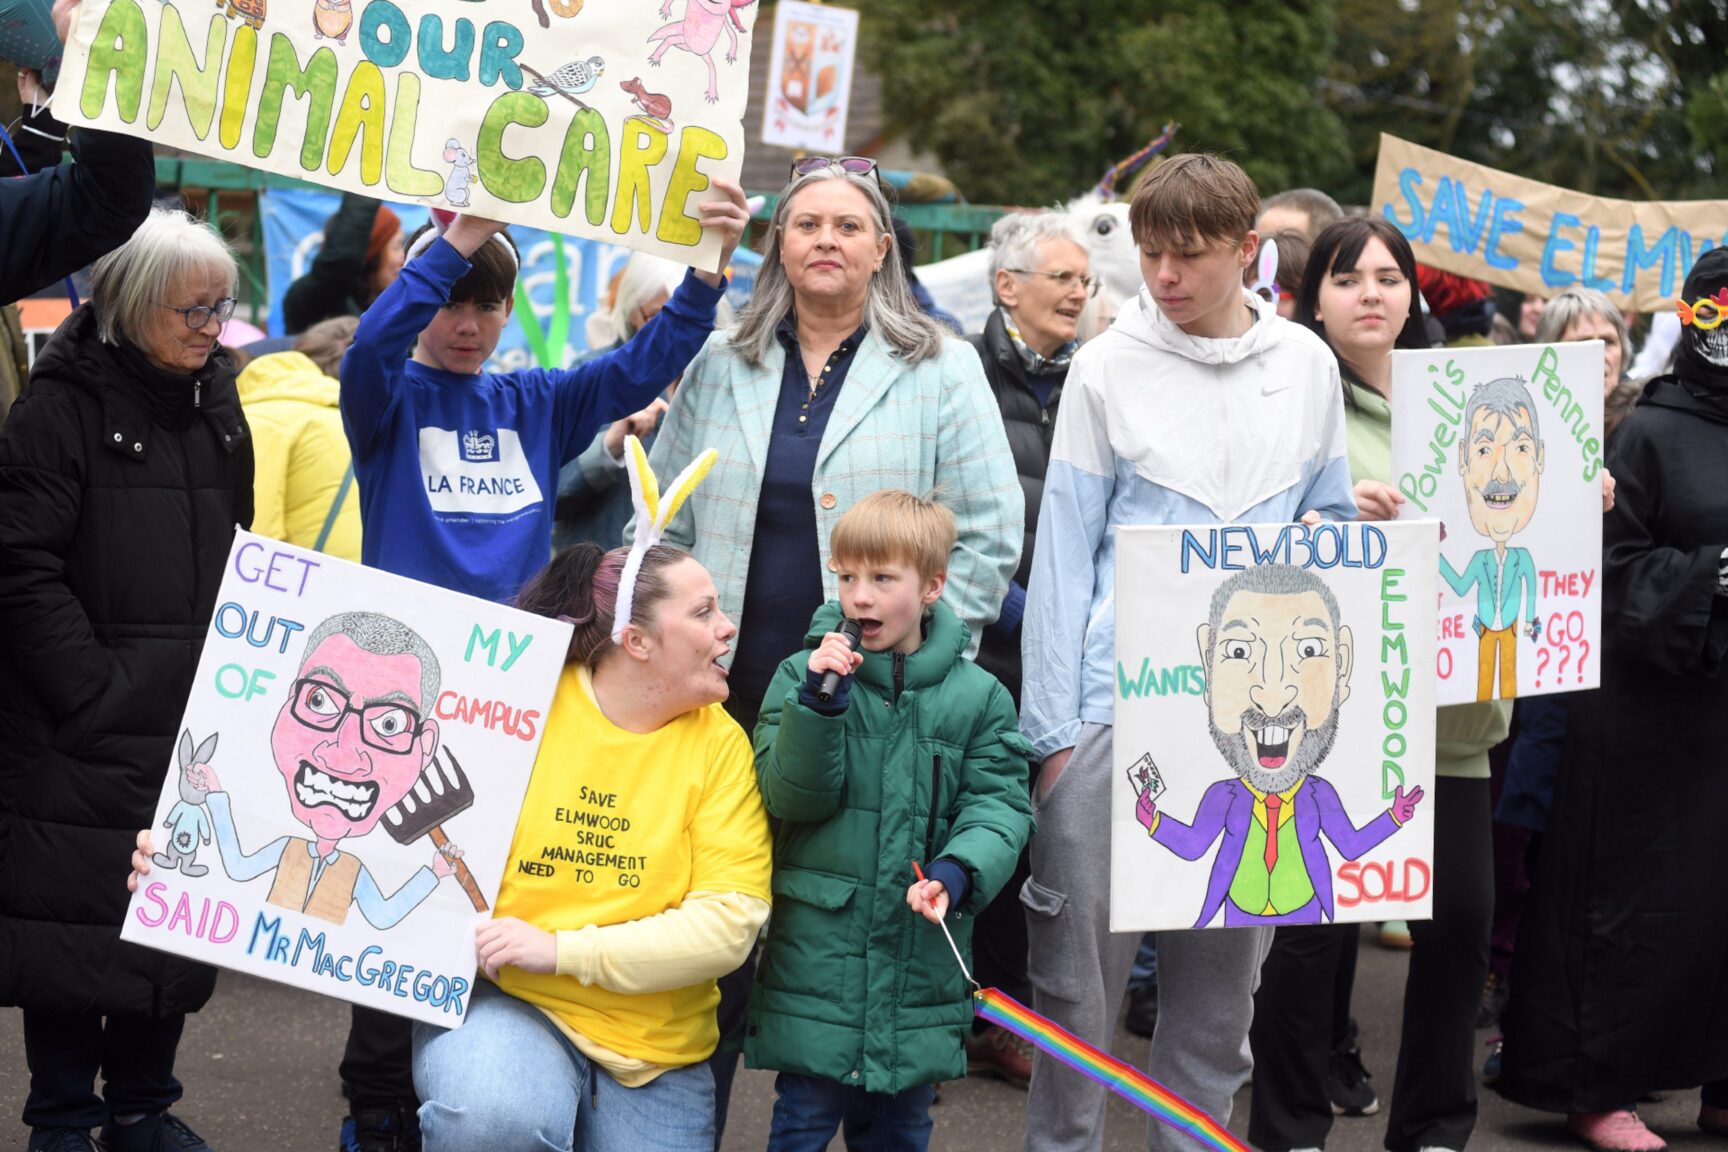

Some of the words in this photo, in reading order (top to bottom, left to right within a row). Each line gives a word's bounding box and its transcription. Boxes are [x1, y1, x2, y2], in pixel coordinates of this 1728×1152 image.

[359, 0, 524, 90] OUR
[80, 0, 445, 197] ANIMAL
[477, 91, 728, 247] CARE
[1383, 167, 1526, 271] SAVE
[1399, 359, 1467, 513] Powell's
[1531, 346, 1604, 482] Pennies
[428, 475, 453, 493] LA
[460, 475, 525, 496] FRANCE
[235, 542, 321, 597] GET
[1181, 524, 1387, 573] NEWBOLD
[1539, 569, 1595, 598] THEY
[215, 602, 305, 654] OUT
[464, 623, 534, 672] MY
[1546, 610, 1584, 647] GO
[215, 663, 277, 702] OF
[1117, 656, 1205, 700] WANTS
[1380, 568, 1411, 801] ELMWOOD
[1535, 639, 1590, 689] ???
[435, 690, 541, 741] CAMPUS
[555, 807, 631, 832] ELMWOOD
[579, 786, 617, 808] SAVE
[576, 830, 616, 849] SRUC
[518, 860, 555, 878] NEED
[575, 869, 594, 884] TO
[618, 873, 641, 888] GO
[1336, 857, 1431, 908] SOLD
[136, 882, 240, 944] SAID
